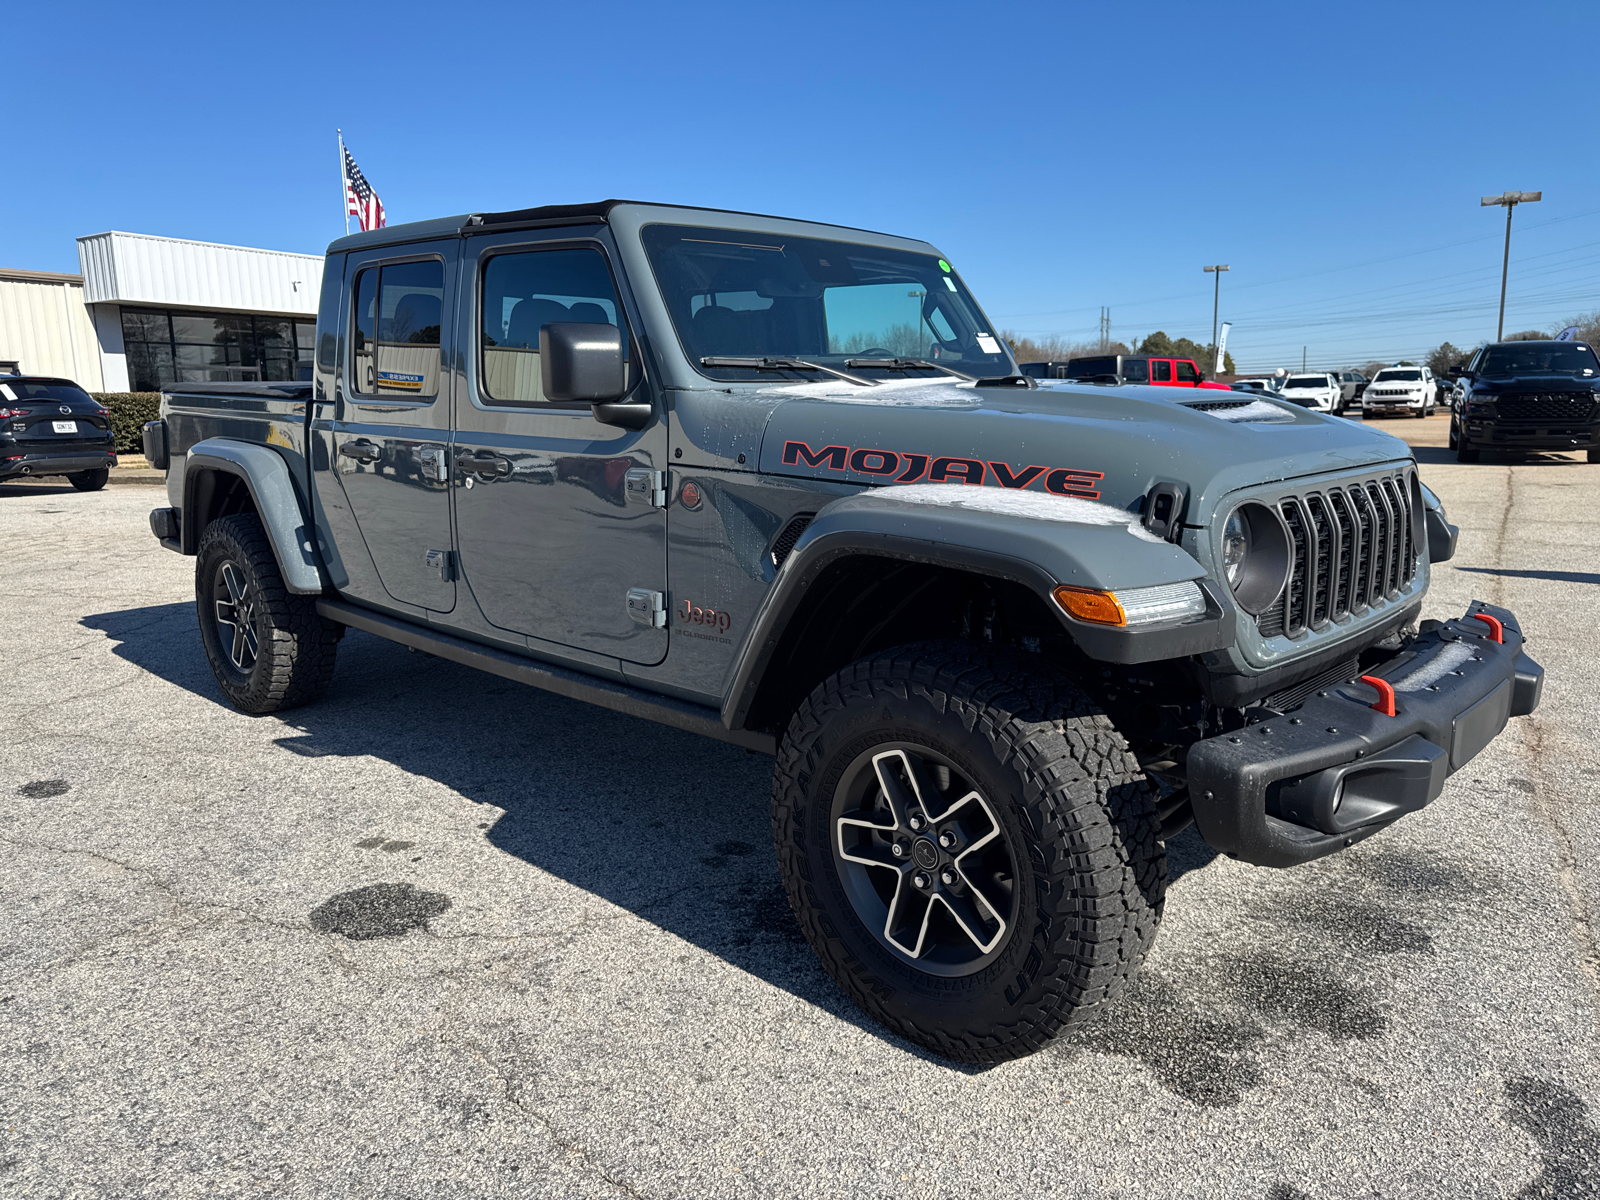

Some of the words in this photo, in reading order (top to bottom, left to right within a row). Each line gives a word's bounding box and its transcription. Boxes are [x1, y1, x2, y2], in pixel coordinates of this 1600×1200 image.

[781, 440, 1105, 500] MOJAVE
[677, 599, 731, 634] Jeep
[682, 629, 732, 645] GLADIATOR
[795, 734, 825, 796] A/T
[792, 798, 895, 1001] WILDPEAK
[1004, 795, 1053, 1006] FALKEN
